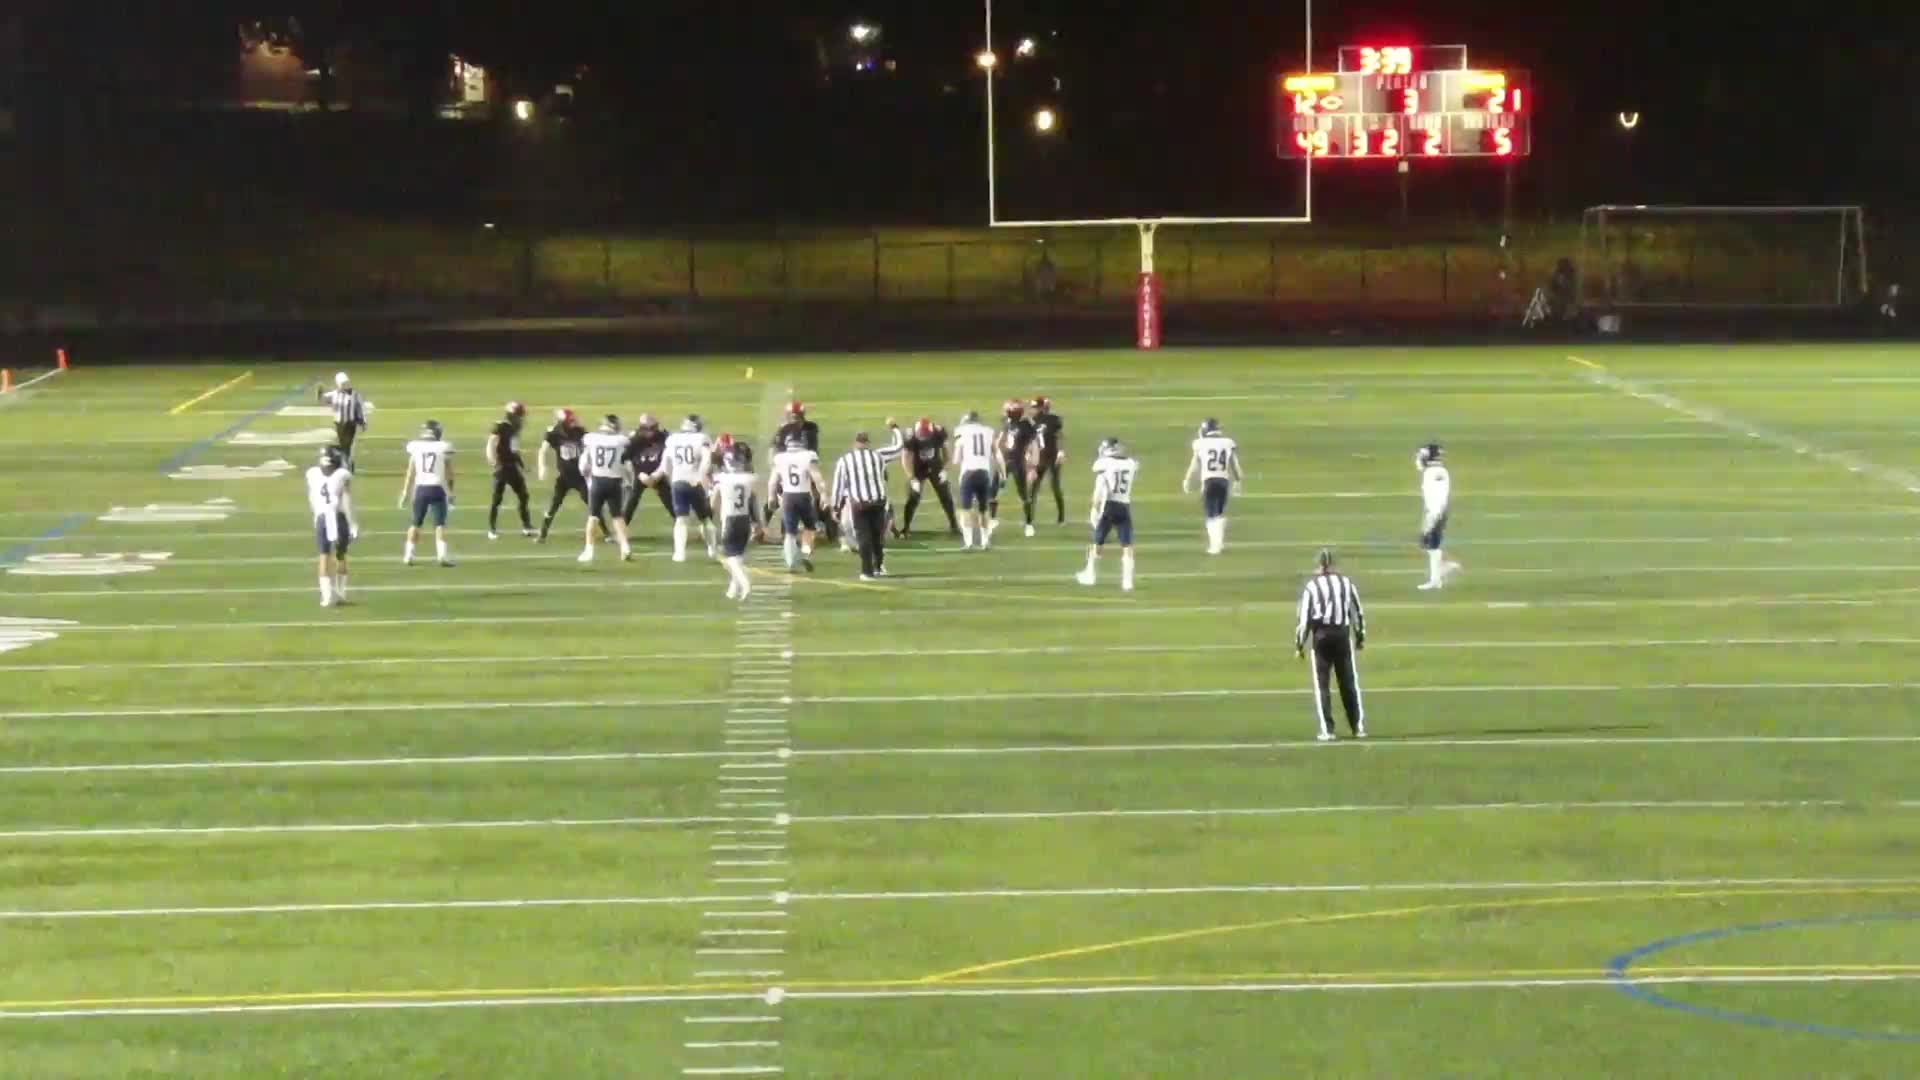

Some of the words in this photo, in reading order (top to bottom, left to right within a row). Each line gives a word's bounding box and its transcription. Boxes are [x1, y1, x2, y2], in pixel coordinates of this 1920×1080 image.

[1404, 88, 1418, 115] 3
[1488, 88, 1521, 114] 21
[1296, 130, 1328, 156] 49
[1352, 129, 1368, 156] 3
[1381, 128, 1399, 155] 2
[1424, 128, 1441, 155] 2
[1495, 128, 1512, 155] 5
[674, 446, 695, 465] 50
[972, 433, 985, 456] 11
[422, 452, 437, 473] 17
[596, 447, 617, 468] 87
[1207, 449, 1227, 472] 24
[788, 464, 800, 487] 6
[1112, 469, 1130, 494] 15
[320, 482, 331, 505] 4
[733, 484, 746, 509] 3
